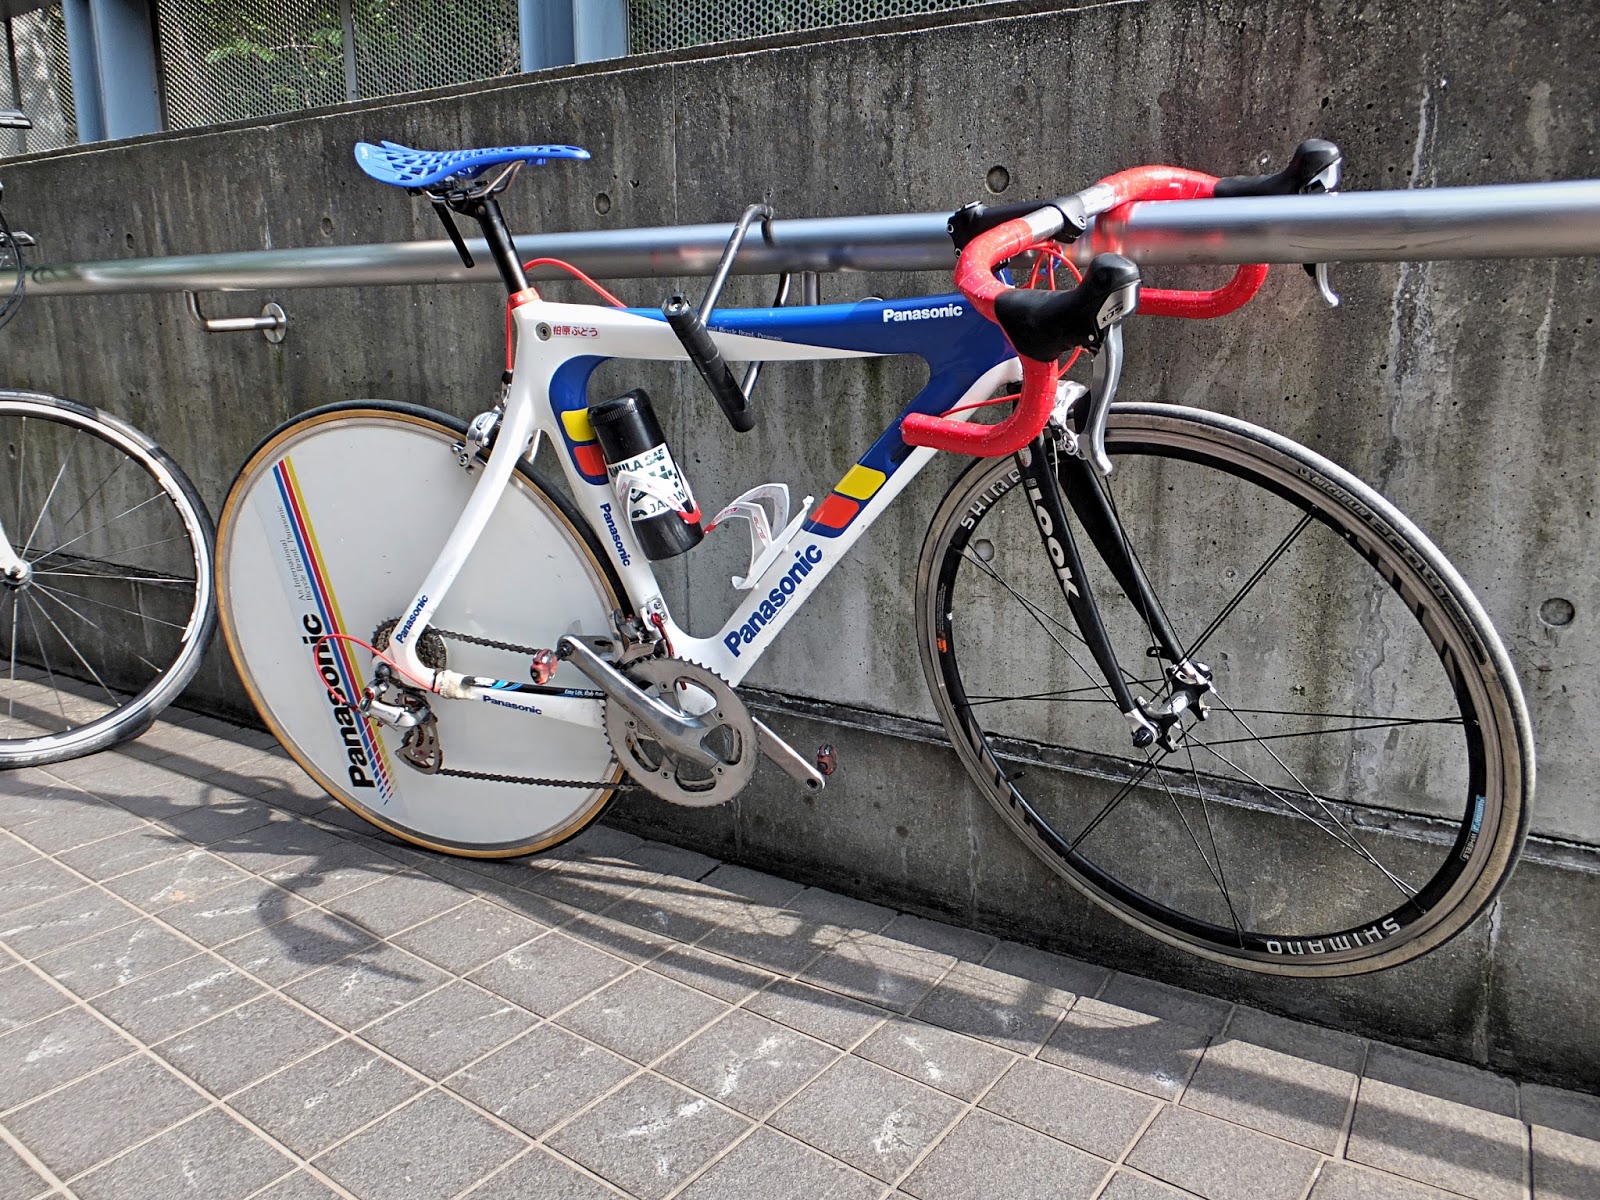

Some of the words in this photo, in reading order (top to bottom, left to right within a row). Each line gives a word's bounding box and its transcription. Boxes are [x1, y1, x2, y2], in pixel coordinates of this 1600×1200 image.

[883, 303, 963, 322] Panasonic
[649, 488, 686, 514] JAN
[1310, 476, 1369, 518] MICHELIN
[277, 505, 294, 543] Panasonic
[600, 502, 631, 567] Panasonic
[1028, 487, 1081, 599] LOOK
[280, 540, 301, 588] International
[395, 594, 429, 644] Panasonic
[724, 544, 823, 658] Panasonic
[303, 613, 376, 788] Panasonic
[482, 695, 542, 715] Panasonic
[1462, 833, 1478, 860] WHEELS
[1266, 917, 1401, 955] SHIMANO
